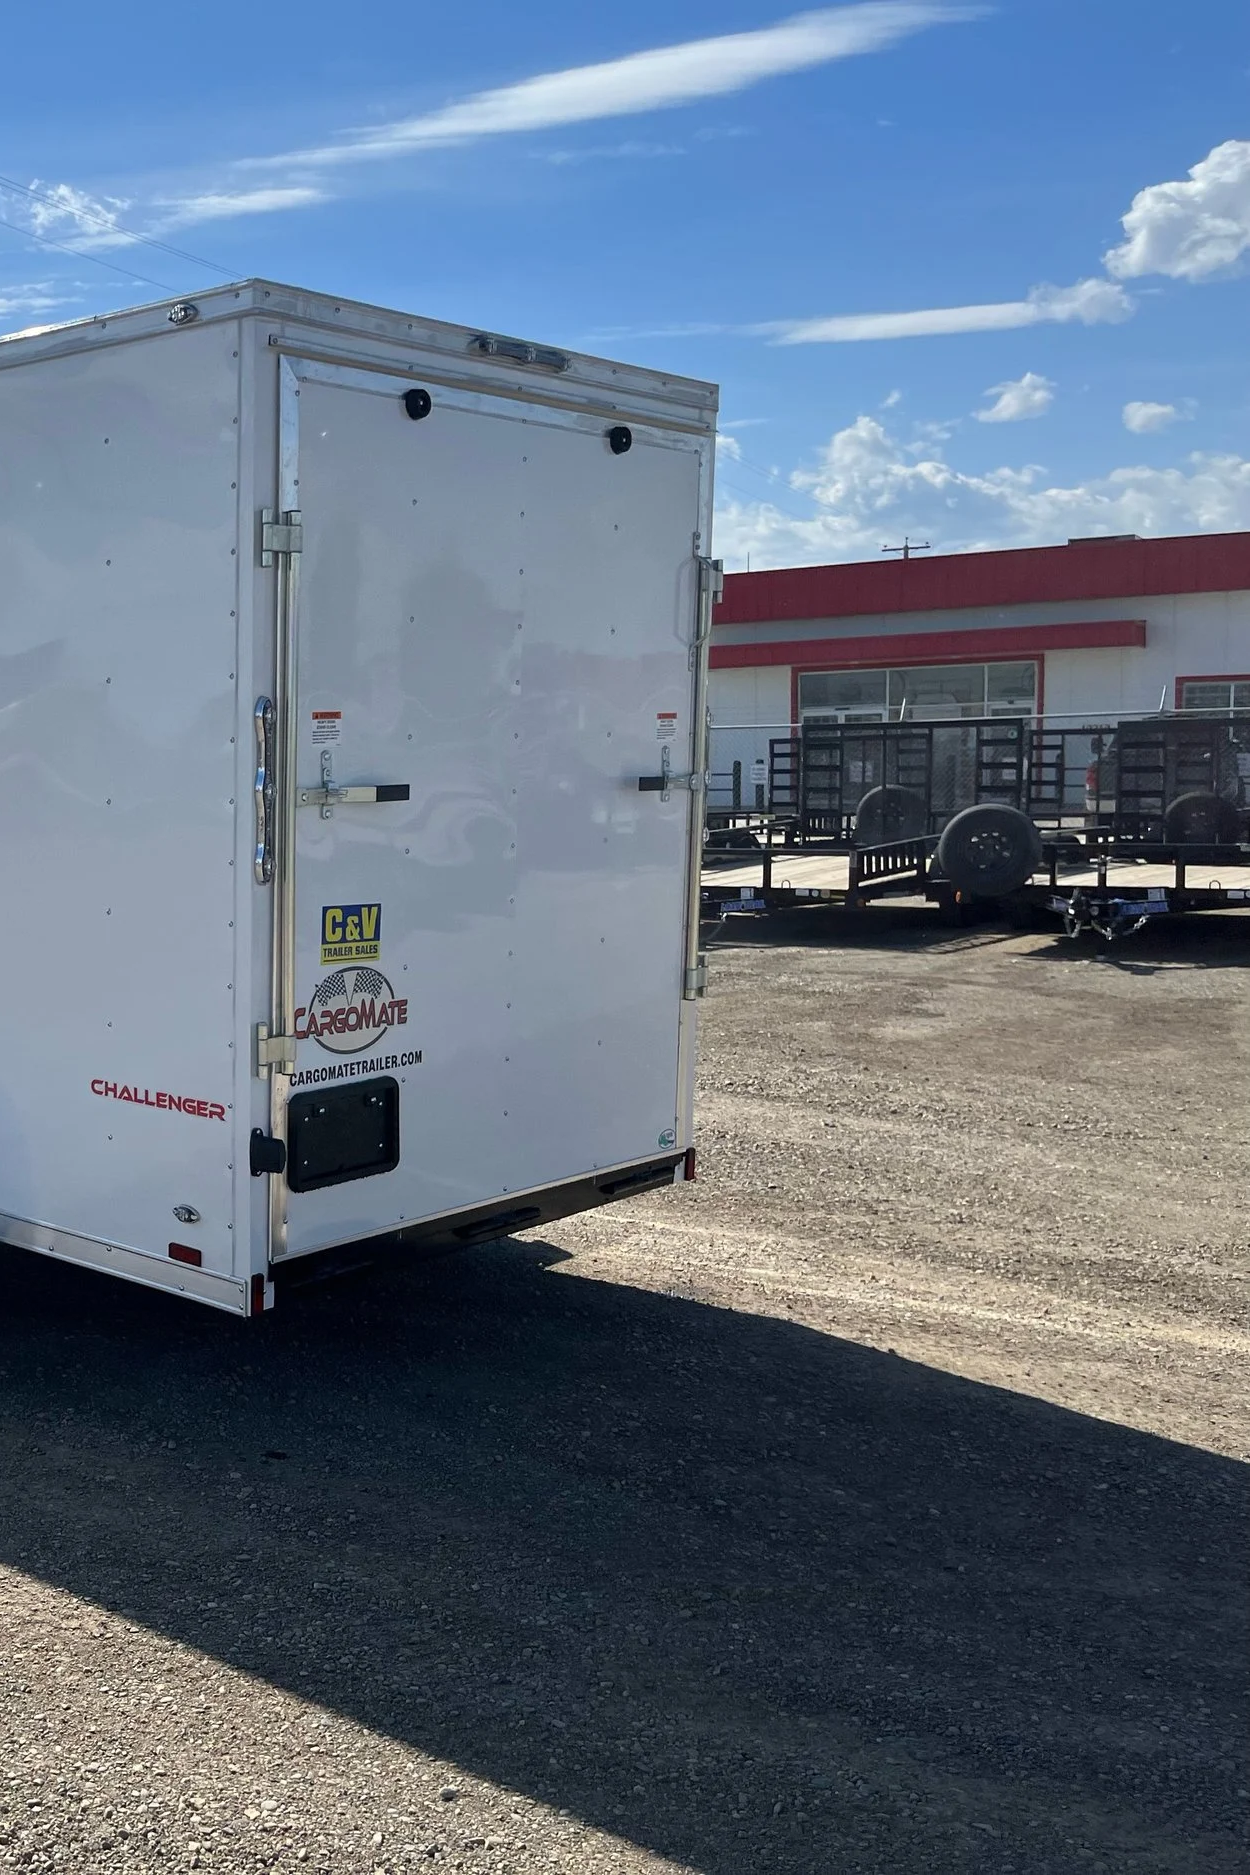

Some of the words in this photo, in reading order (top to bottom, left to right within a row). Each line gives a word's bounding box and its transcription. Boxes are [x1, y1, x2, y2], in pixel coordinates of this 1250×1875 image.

[325, 905, 379, 943] C&V
[323, 946, 353, 958] TRAILER
[355, 944, 378, 955] SALES
[290, 1050, 423, 1087] CARGOMATETRAILER.COM
[90, 1079, 226, 1121] CHALLENGER
